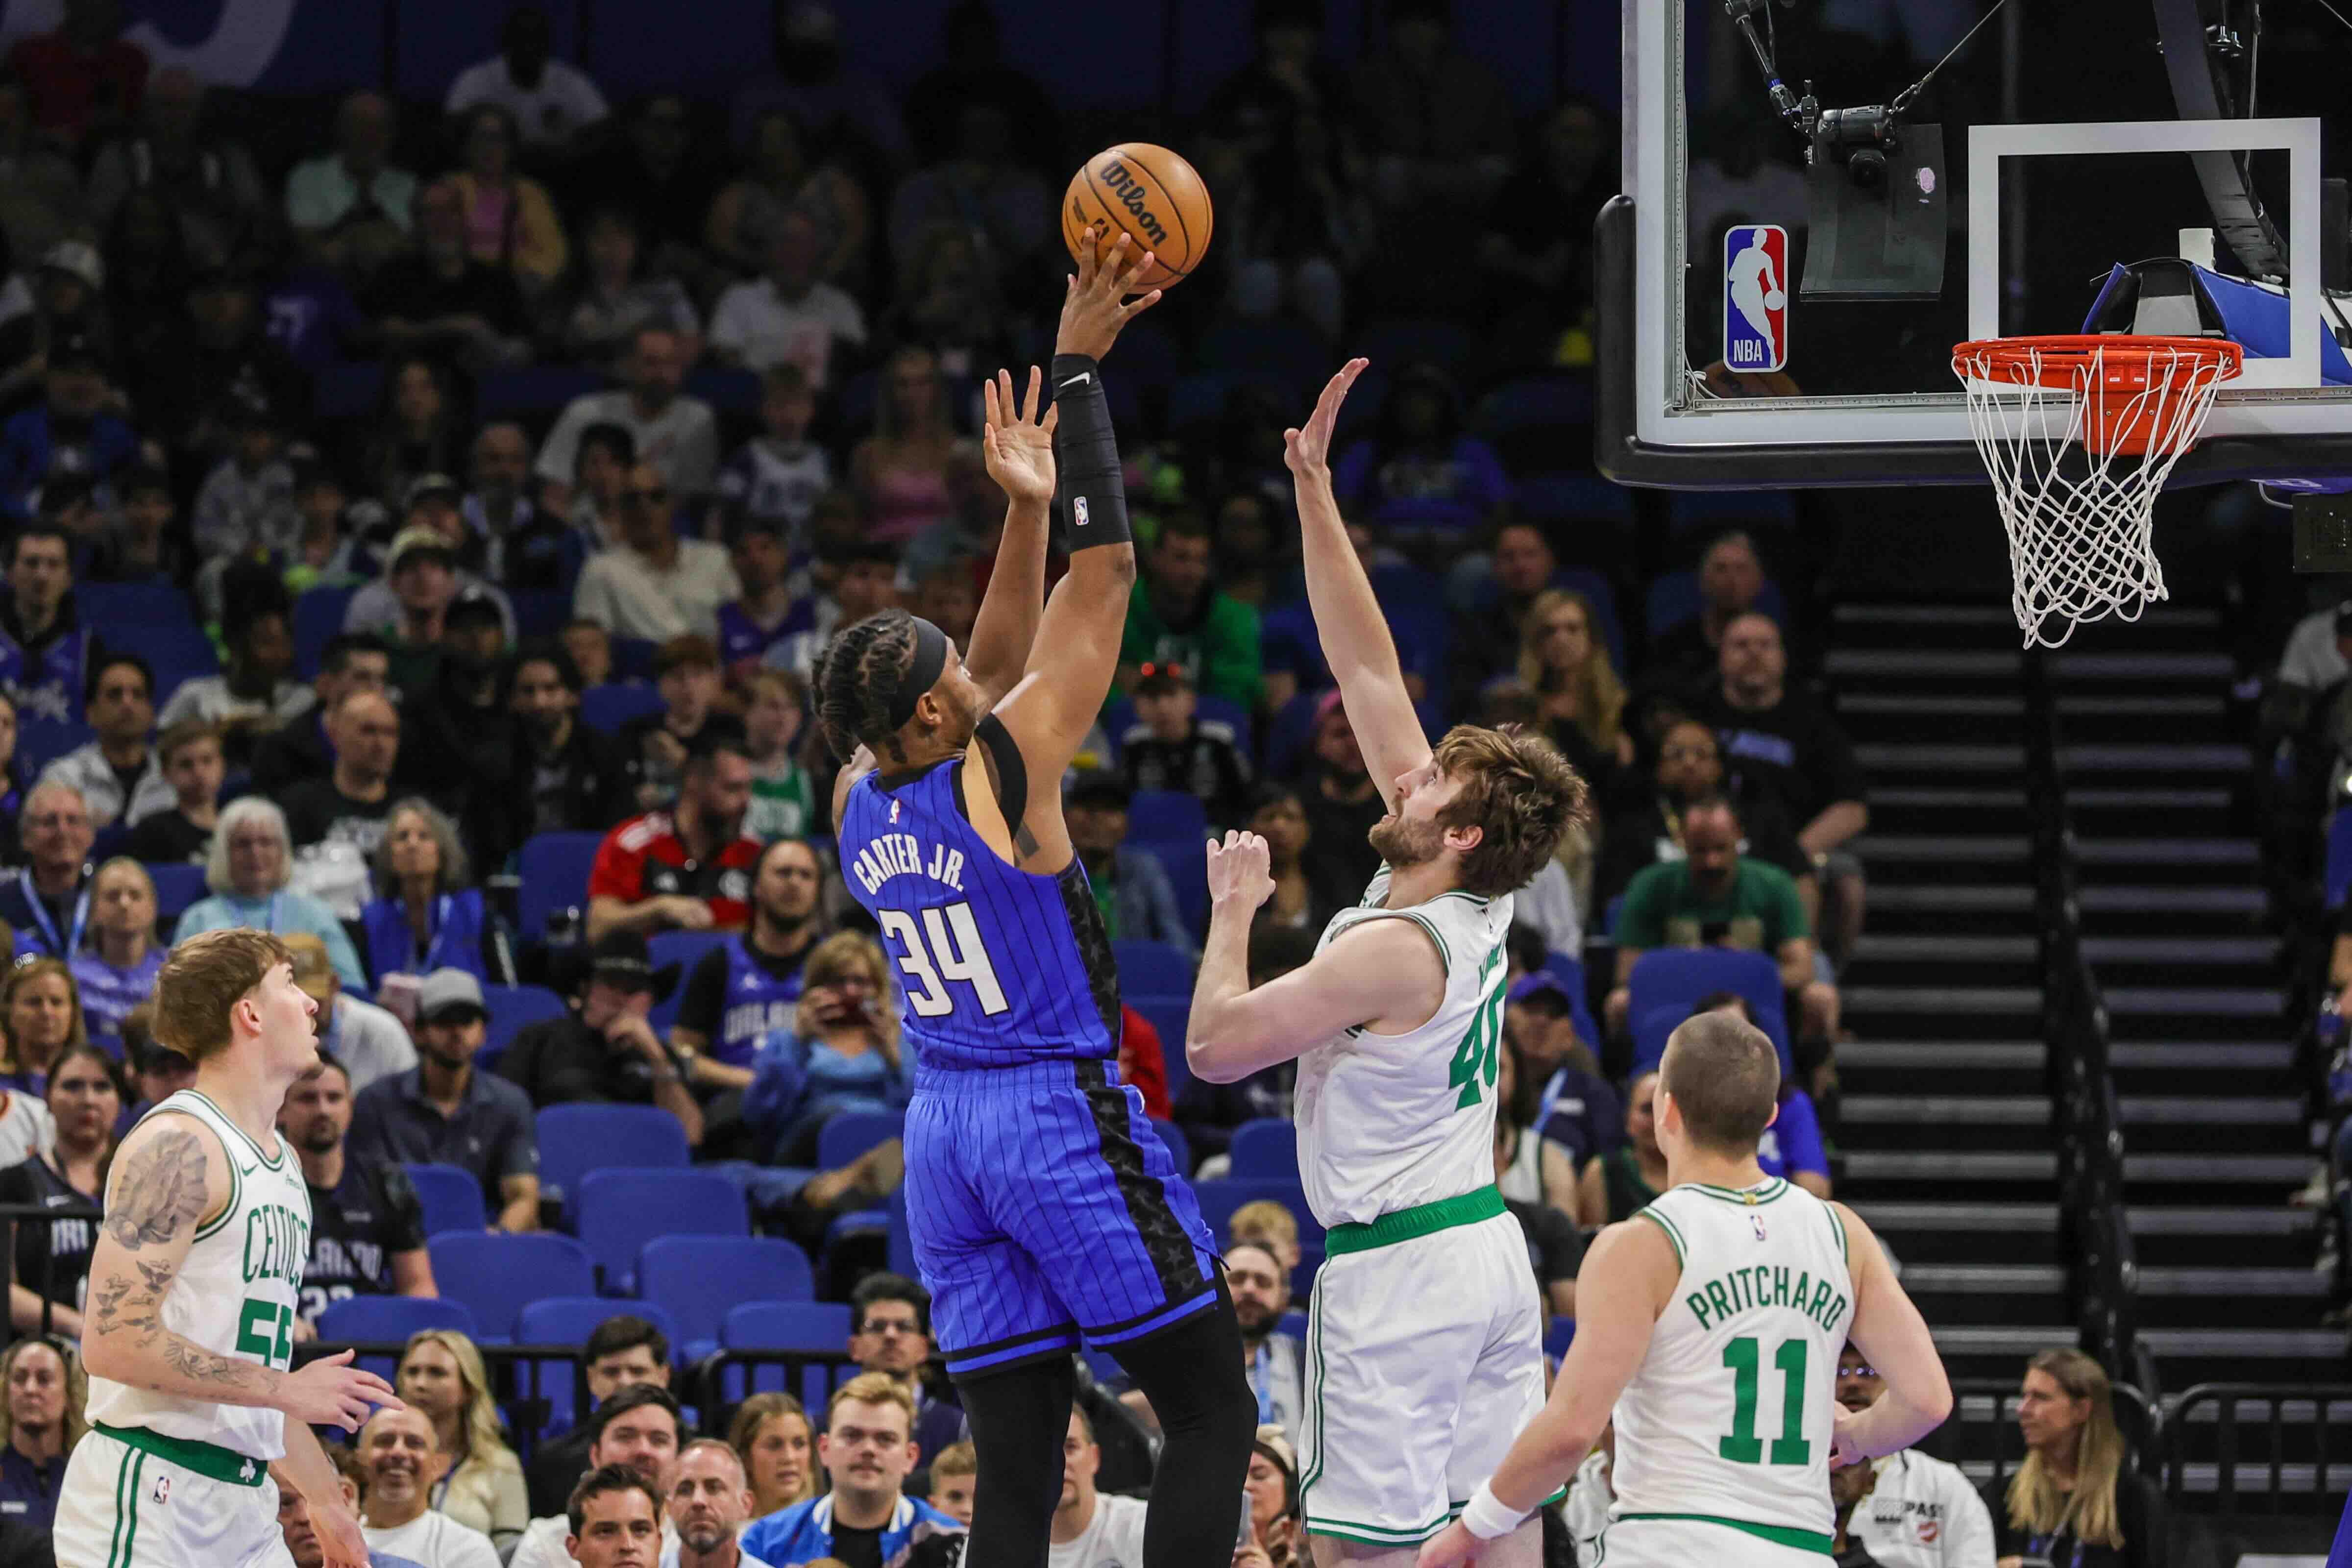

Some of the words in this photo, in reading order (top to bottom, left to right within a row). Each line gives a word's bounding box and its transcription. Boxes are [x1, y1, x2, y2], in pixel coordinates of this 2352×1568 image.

[1101, 159, 1167, 247] Wilson
[1734, 339, 1763, 362] NBA
[853, 833, 923, 895] CARTER
[928, 843, 964, 892] JR.
[878, 901, 1009, 1018] 34
[1686, 1266, 1846, 1332] PRITCHARD
[1719, 1337, 1811, 1466] 11
